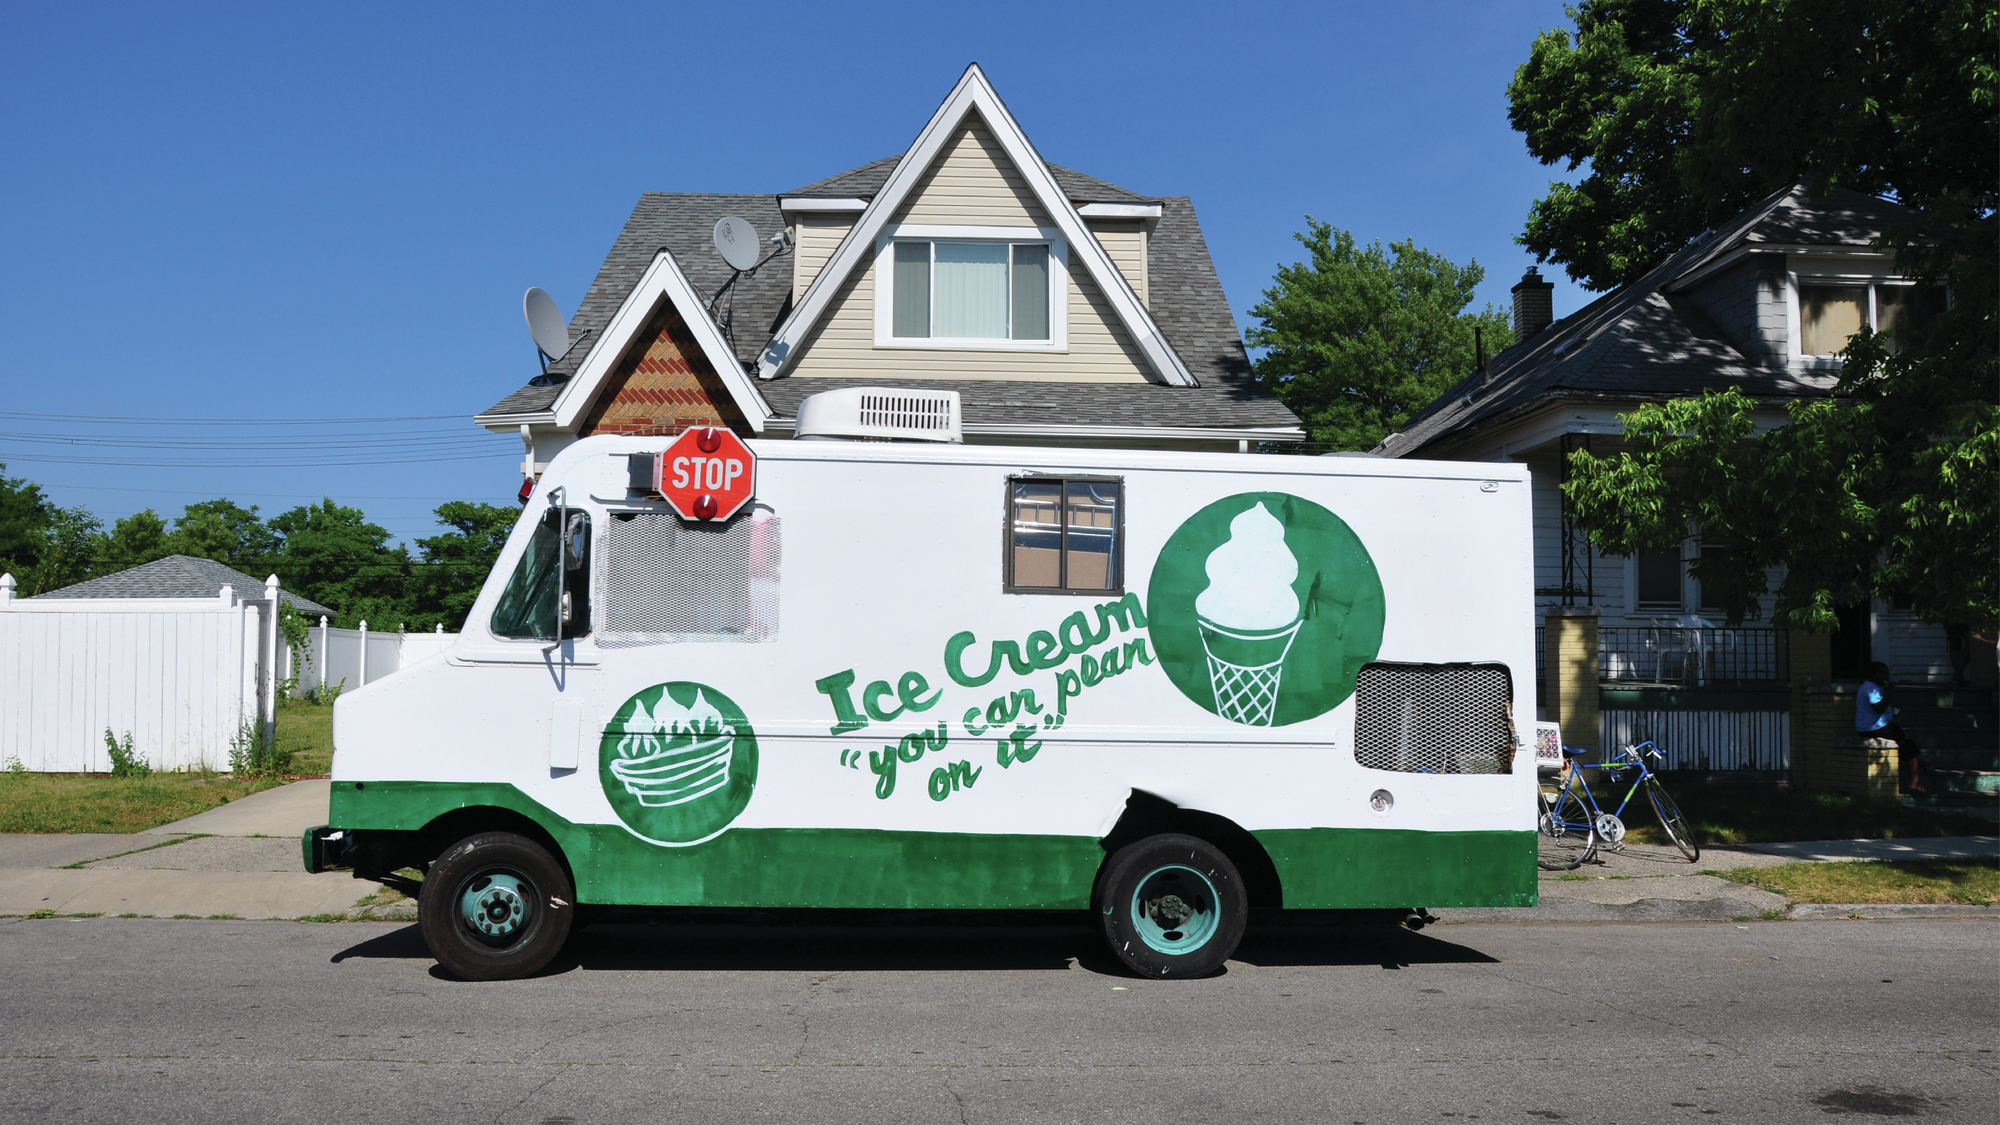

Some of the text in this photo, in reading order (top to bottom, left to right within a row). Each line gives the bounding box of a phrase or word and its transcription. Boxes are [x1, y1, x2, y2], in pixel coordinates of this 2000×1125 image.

[671, 456, 744, 491] STOP
[815, 592, 1149, 736] Ice Cream
[963, 688, 1044, 736] can
[1055, 638, 1157, 716] pean
[928, 759, 982, 802] on
